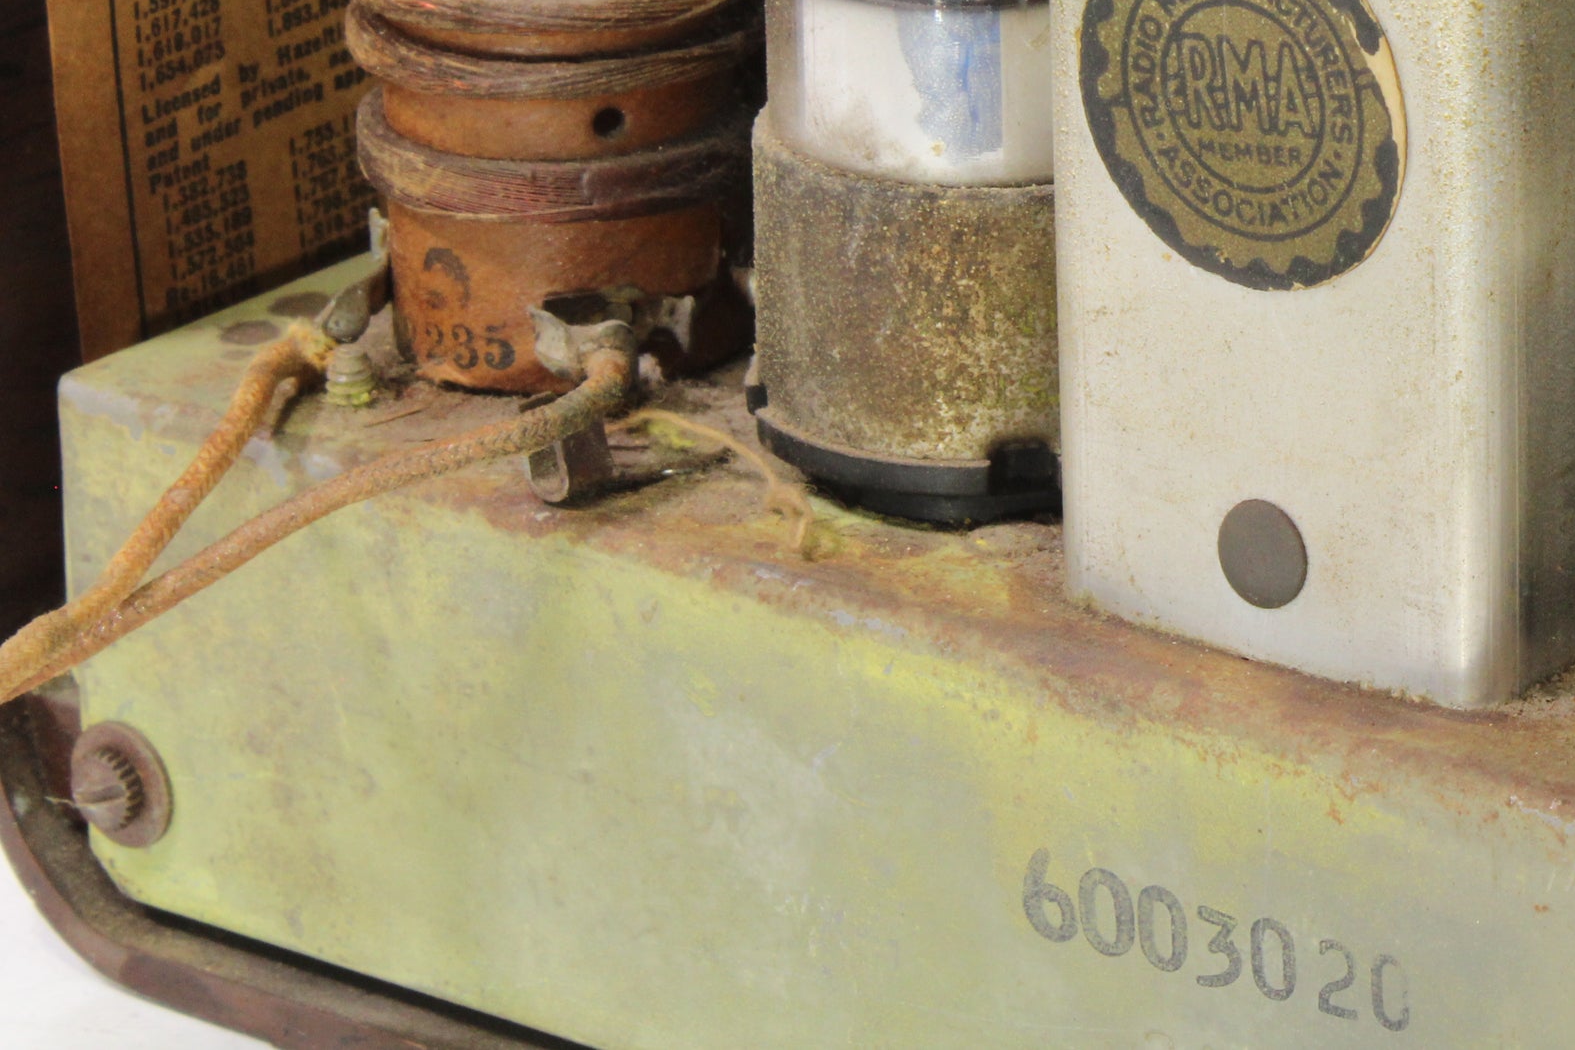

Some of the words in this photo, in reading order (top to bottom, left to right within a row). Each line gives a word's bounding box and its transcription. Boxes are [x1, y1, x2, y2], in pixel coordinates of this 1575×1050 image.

[276, 23, 347, 67] Hazelti
[1131, 15, 1164, 129] RADIO
[1176, 32, 1324, 140] RMA
[1158, 144, 1346, 228] ASSOCIATION
[1197, 138, 1303, 167] MEMBER
[1021, 847, 1412, 1033] 6003020
